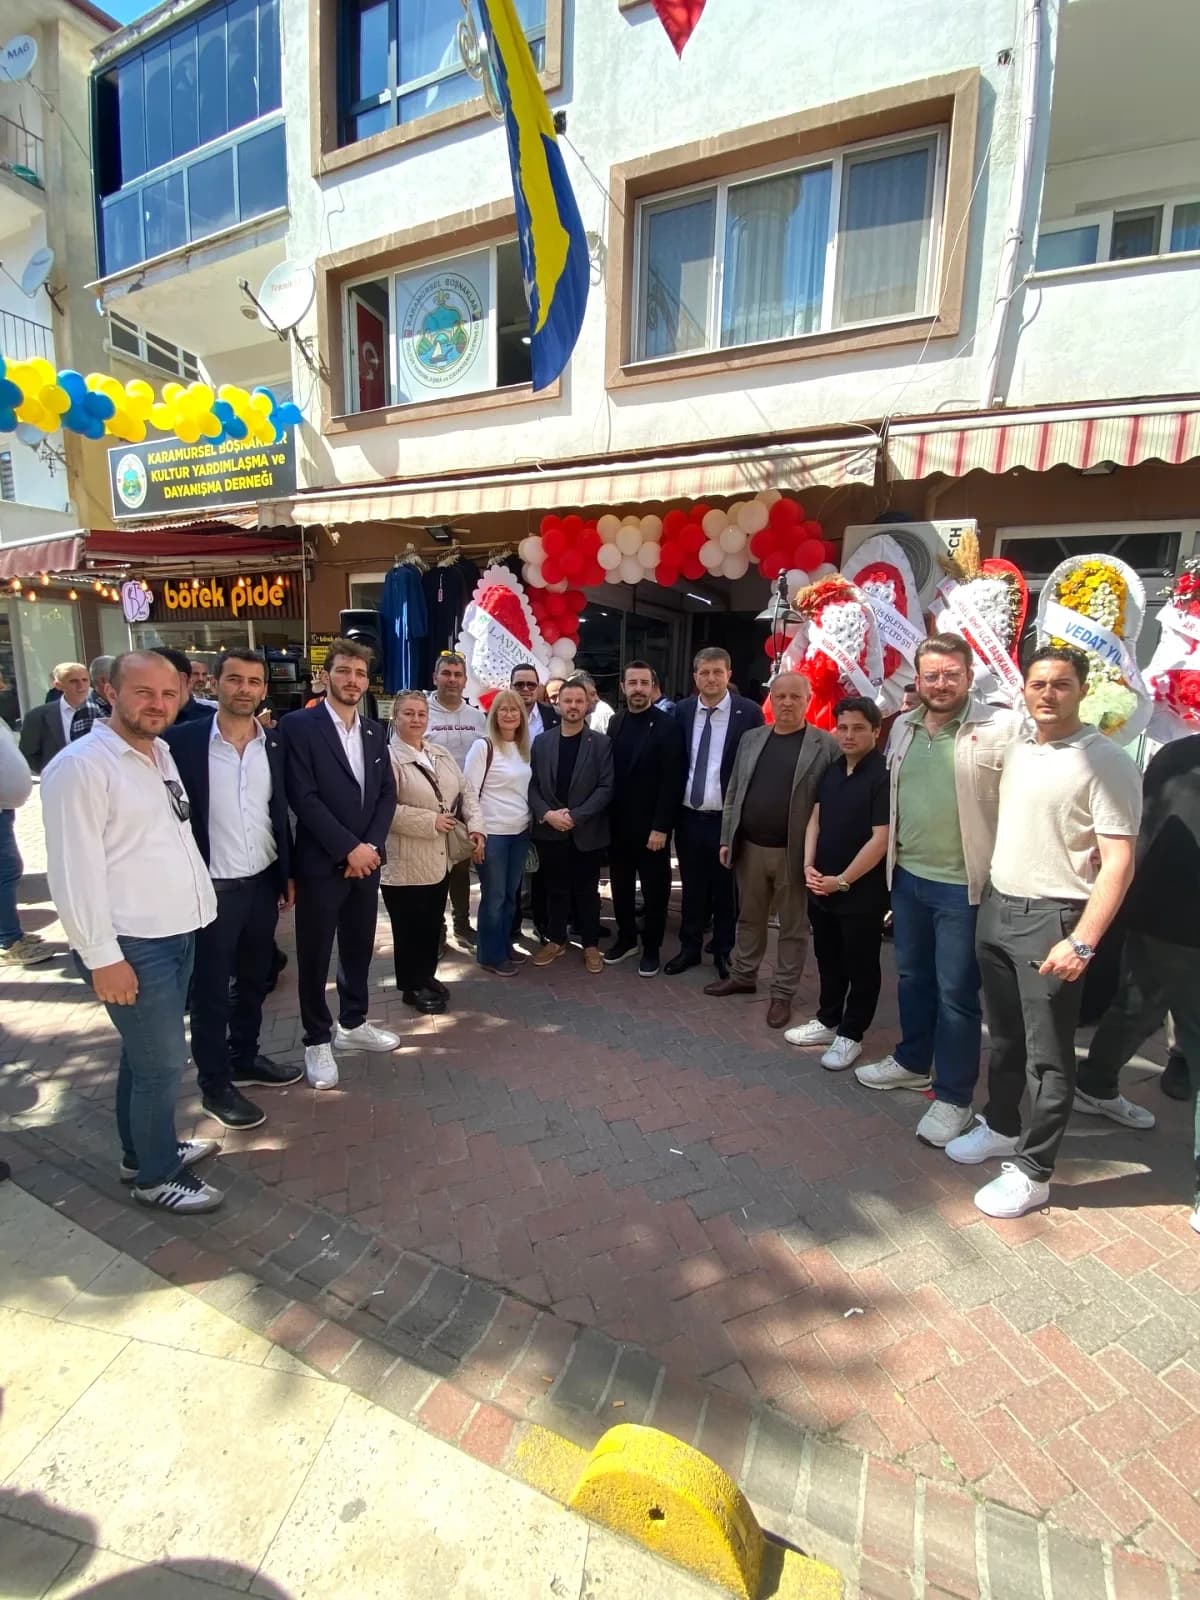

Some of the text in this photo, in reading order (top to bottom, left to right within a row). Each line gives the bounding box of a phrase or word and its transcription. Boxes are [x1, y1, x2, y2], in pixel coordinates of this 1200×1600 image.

[191, 454, 269, 478] YARDIMLAŞMA
[271, 454, 286, 465] ve
[164, 480, 222, 498] DAYANIŞMA
[164, 575, 284, 618] börek pide
[1064, 621, 1108, 651] VEDAT
